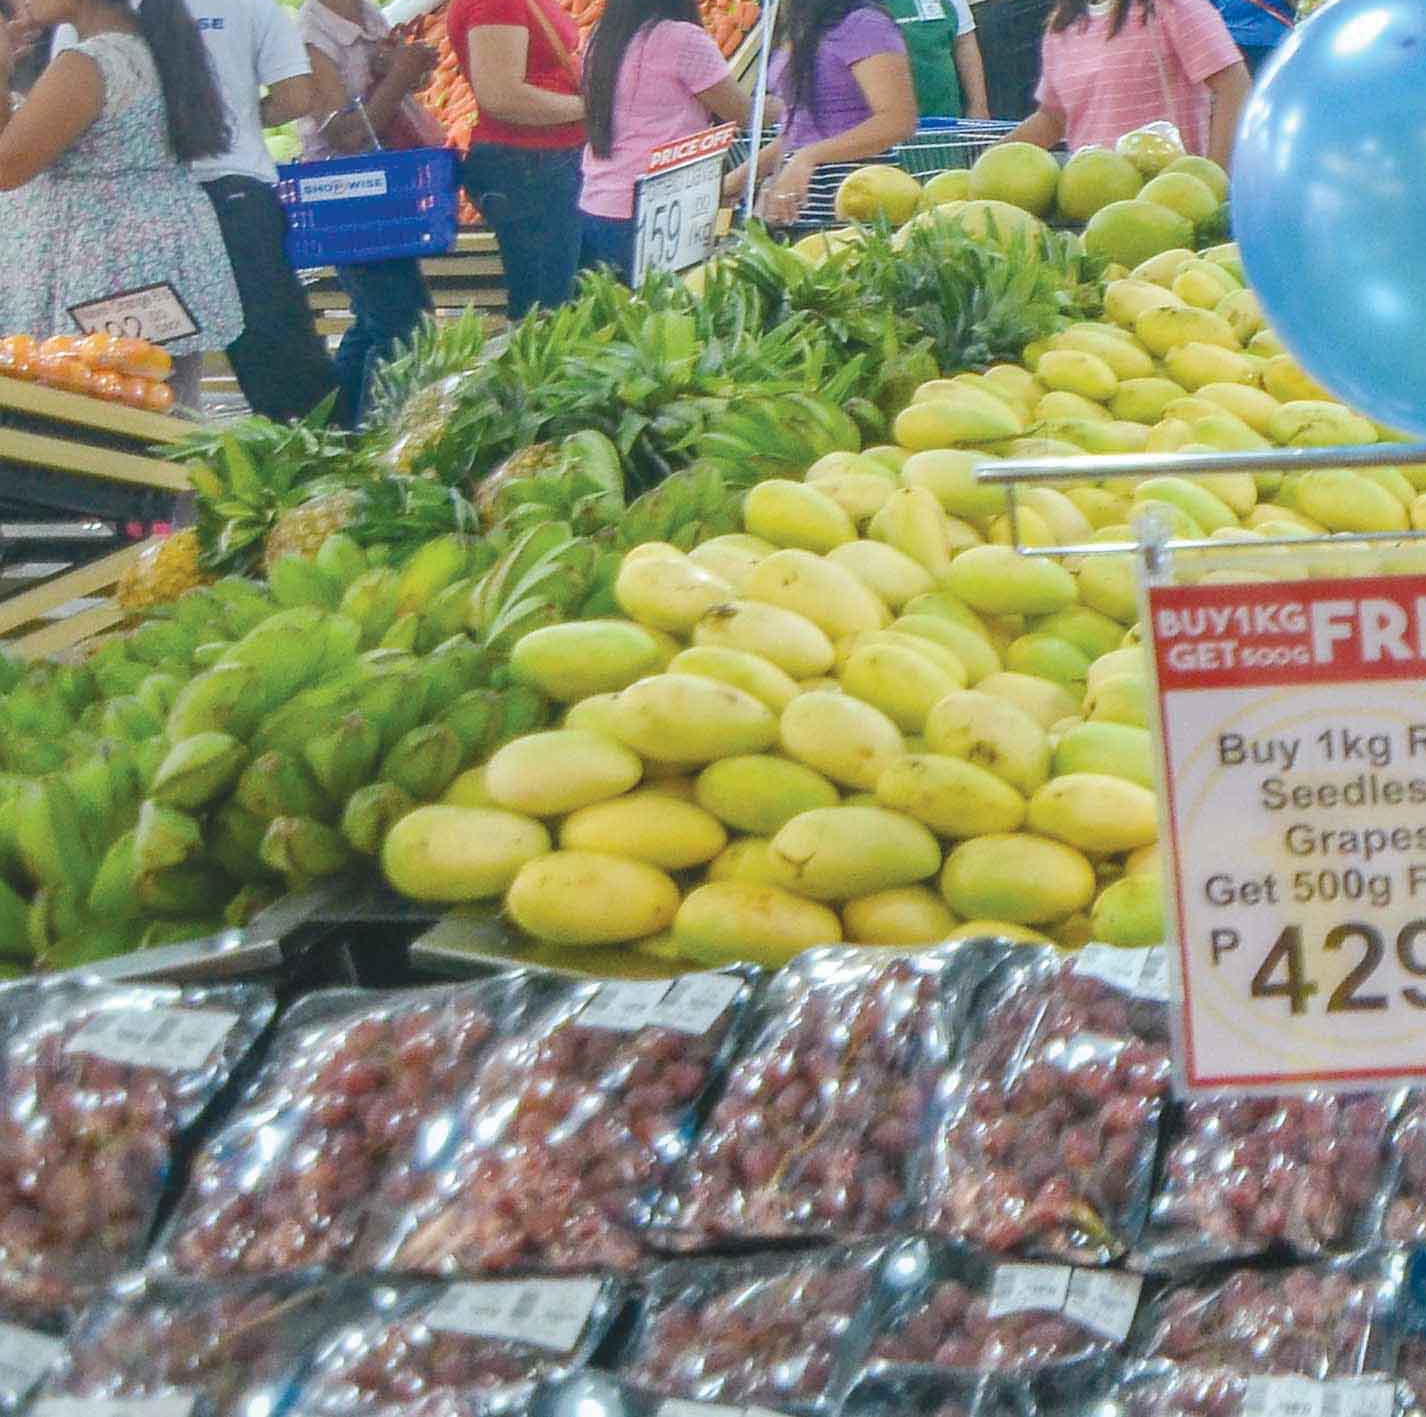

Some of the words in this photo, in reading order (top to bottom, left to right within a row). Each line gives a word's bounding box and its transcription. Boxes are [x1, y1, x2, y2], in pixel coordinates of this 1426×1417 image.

[651, 137, 698, 170] PRICE
[1167, 642, 1239, 673] GET
[1217, 732, 1301, 773] Buy
[1316, 727, 1392, 768] 1kg
[1203, 872, 1281, 908] Get
[1292, 868, 1393, 909] 500g
